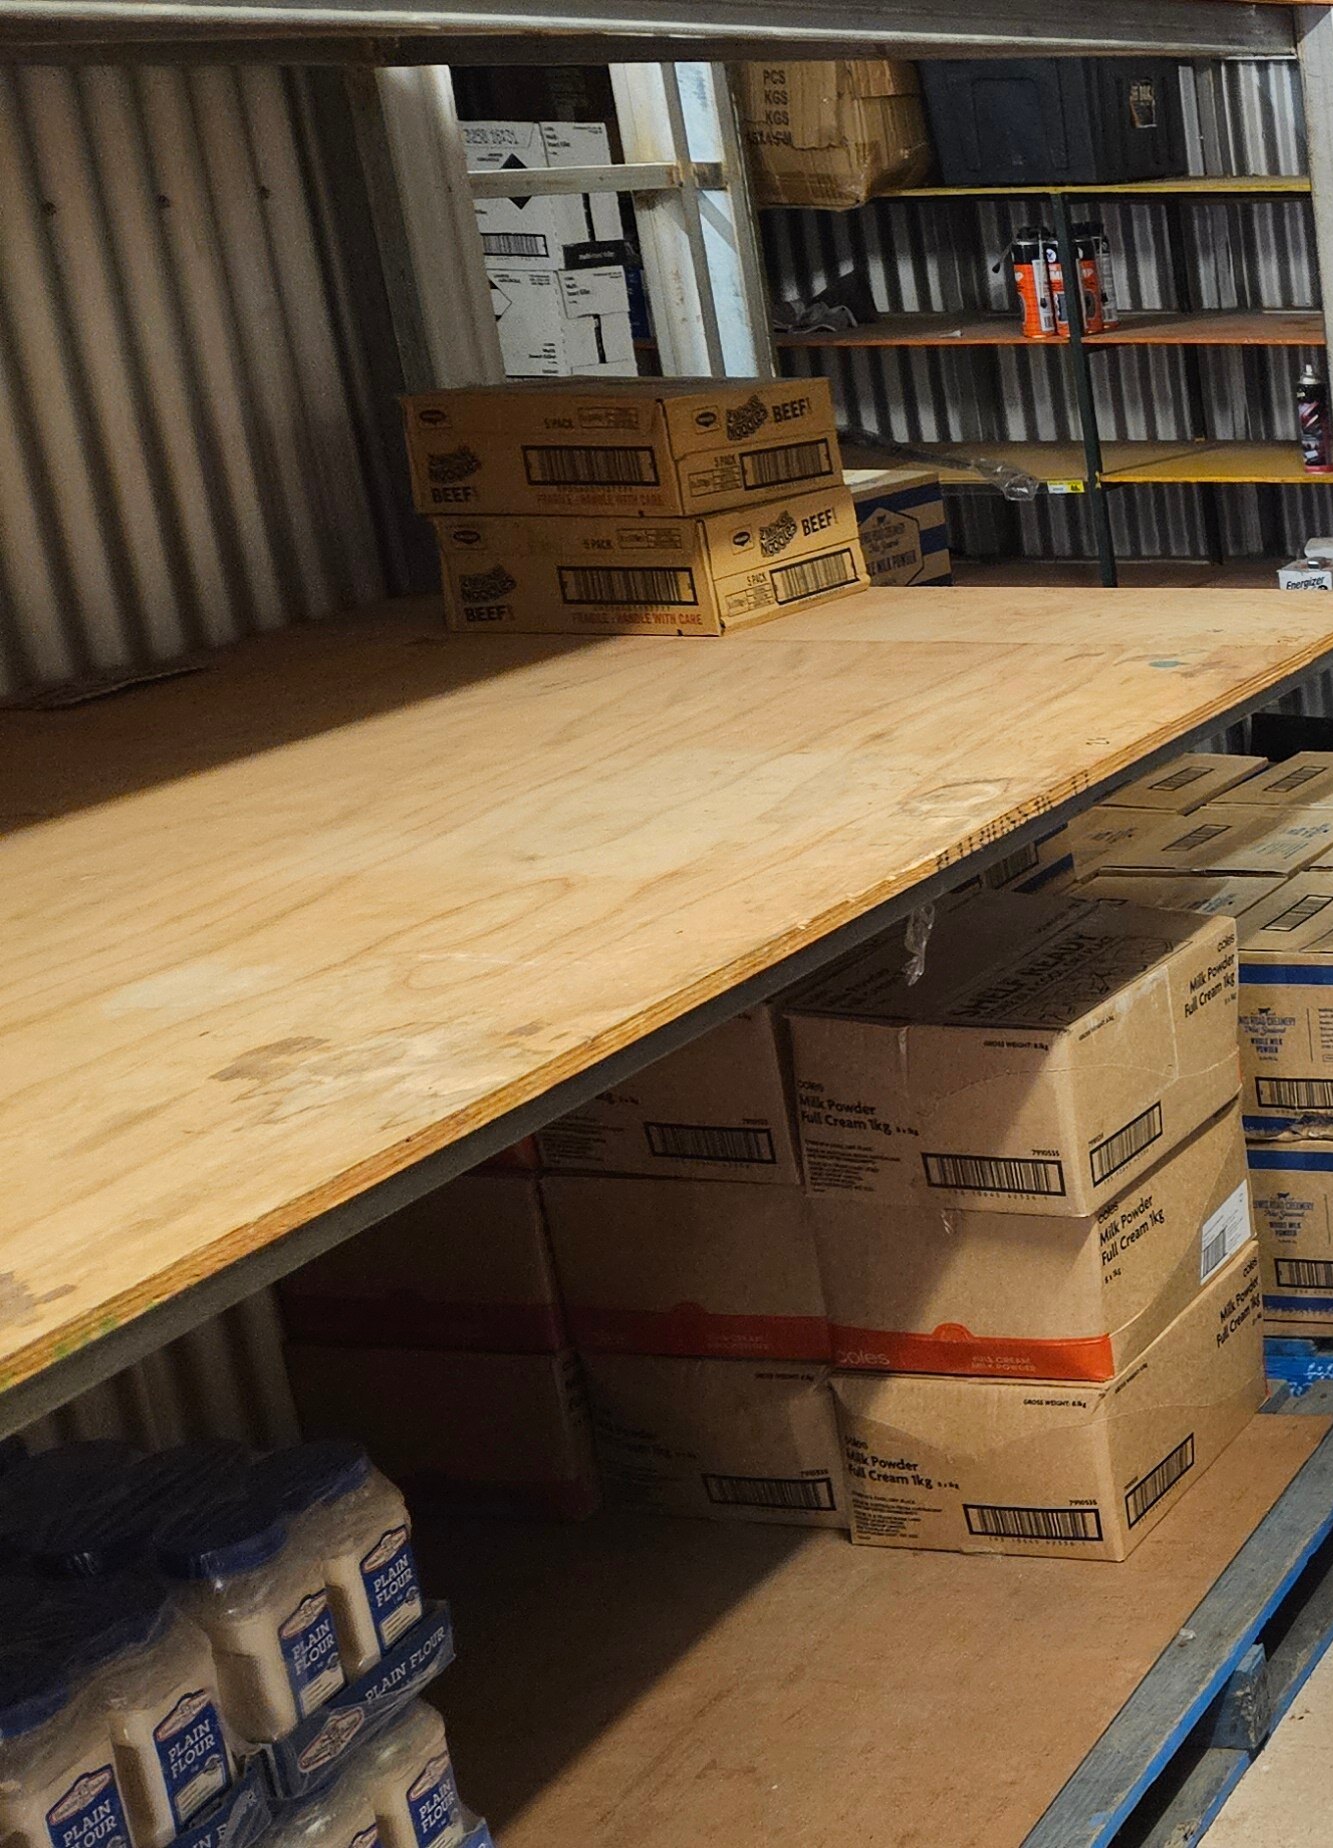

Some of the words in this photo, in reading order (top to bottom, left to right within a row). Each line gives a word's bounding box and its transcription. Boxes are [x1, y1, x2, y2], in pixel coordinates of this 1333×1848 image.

[763, 69, 786, 85] PCS
[772, 397, 813, 424] BEEF!
[801, 507, 838, 537] BEEF!
[1286, 575, 1325, 590] Energizer
[653, 613, 677, 625] WITH
[679, 613, 703, 626] CARE
[1189, 973, 1206, 995] Milk
[1207, 953, 1235, 982] Powder
[1184, 998, 1199, 1019] Full
[1199, 981, 1223, 1006] Cream
[801, 1111, 822, 1126] Full
[825, 1114, 867, 1130] Cream
[869, 1118, 893, 1136] 1kg
[827, 1099, 877, 1115] Powder
[1099, 1221, 1120, 1247] Milk
[1121, 1195, 1153, 1229] Powder
[1102, 1247, 1119, 1267] Full
[1120, 1221, 1150, 1251] Cream
[1149, 1208, 1166, 1227] 1kg
[1219, 1301, 1235, 1323] Milk
[1235, 1276, 1260, 1308] Powder
[1216, 1328, 1230, 1349] Full
[1230, 1305, 1250, 1333] Cream
[868, 1468, 910, 1485] Cream
[911, 1474, 934, 1490] 1kg
[871, 1455, 919, 1471] Powder
[373, 1554, 409, 1593] PLAIN
[375, 1567, 414, 1608] FLOUR
[292, 1620, 331, 1661] PLAIN
[294, 1633, 335, 1676] FLOUR
[365, 1662, 407, 1706] PLAIN
[409, 1626, 446, 1669] FLOUR
[168, 1719, 211, 1763] PLAIN
[170, 1733, 216, 1779] FLOUR
[418, 1779, 453, 1820] PLAIN
[422, 1791, 456, 1834] FLOUR
[63, 1800, 112, 1847] PLAIN
